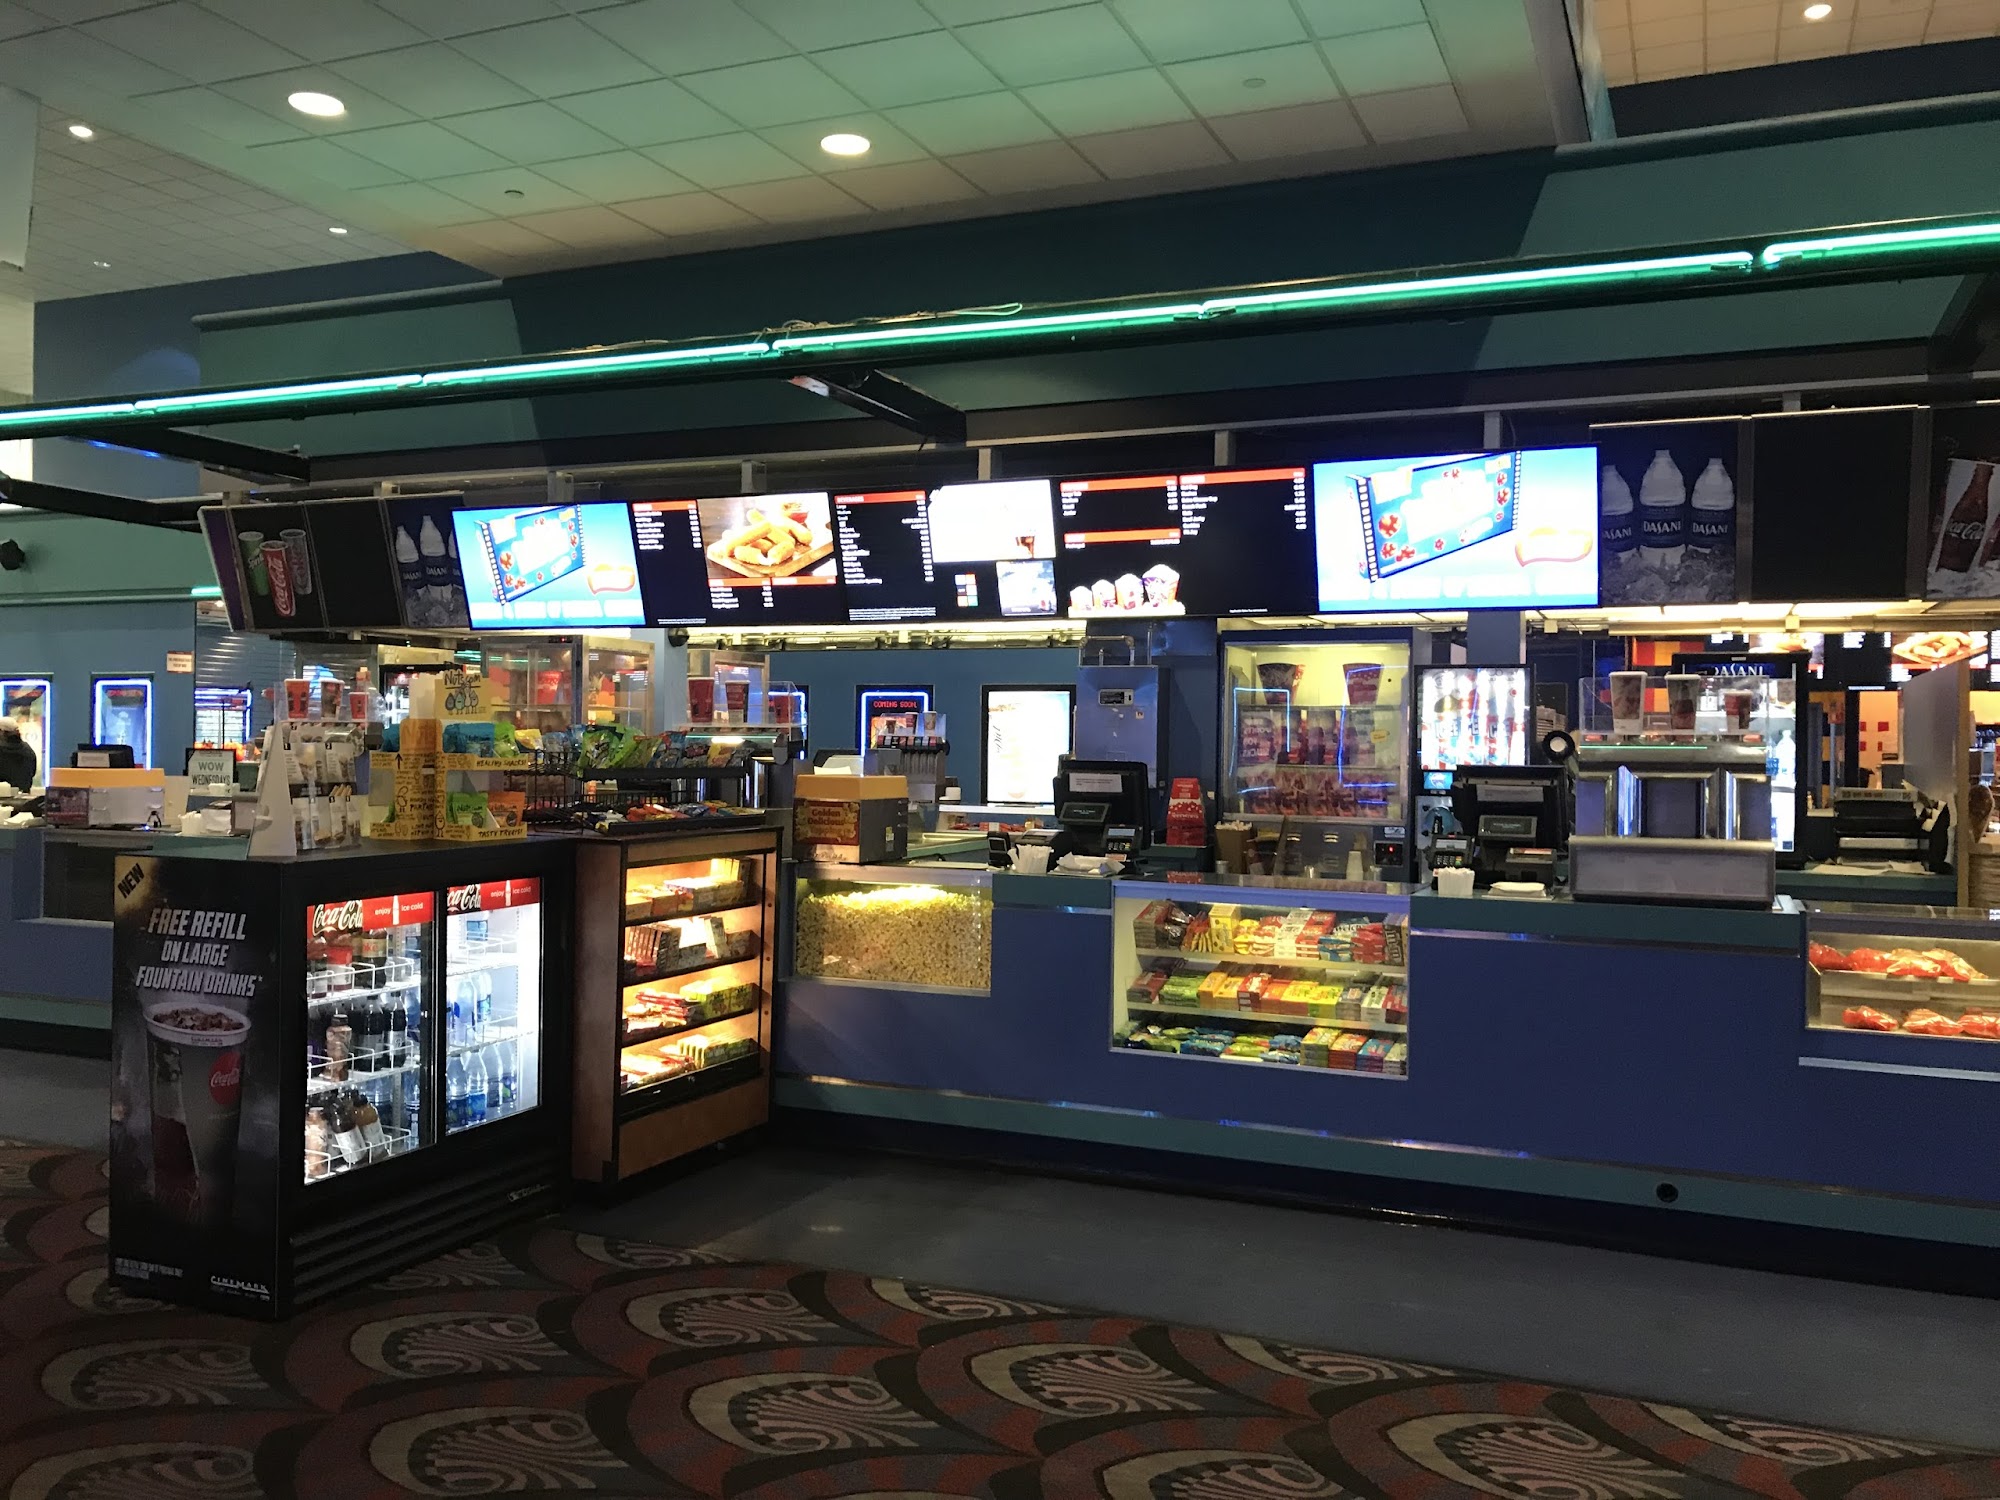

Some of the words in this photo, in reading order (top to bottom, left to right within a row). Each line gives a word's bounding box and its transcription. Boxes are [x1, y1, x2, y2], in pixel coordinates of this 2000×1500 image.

[1601, 526, 1632, 540] ASANI
[1643, 520, 1681, 534] DASANI
[1692, 522, 1728, 535] DASANI
[873, 700, 898, 708] COMING
[899, 701, 917, 709] SOON
[198, 761, 224, 772] WOW
[191, 774, 231, 786] WEDNESDAYS
[811, 808, 841, 817] Golden
[478, 830, 498, 838] TASTY
[117, 863, 146, 899] NEW
[447, 883, 481, 912] ca-Cola
[490, 889, 505, 899] enjoy
[520, 885, 532, 894] cold
[374, 906, 391, 916] enjoy
[411, 902, 424, 911] cold
[147, 907, 191, 937] FREE
[189, 910, 247, 940] REFILL
[312, 899, 363, 937] Coca-Cola
[160, 940, 183, 963] ON
[181, 942, 230, 967] LARGE
[135, 965, 204, 993] FOUNTAIN
[210, 1275, 270, 1295] CINEMARK
